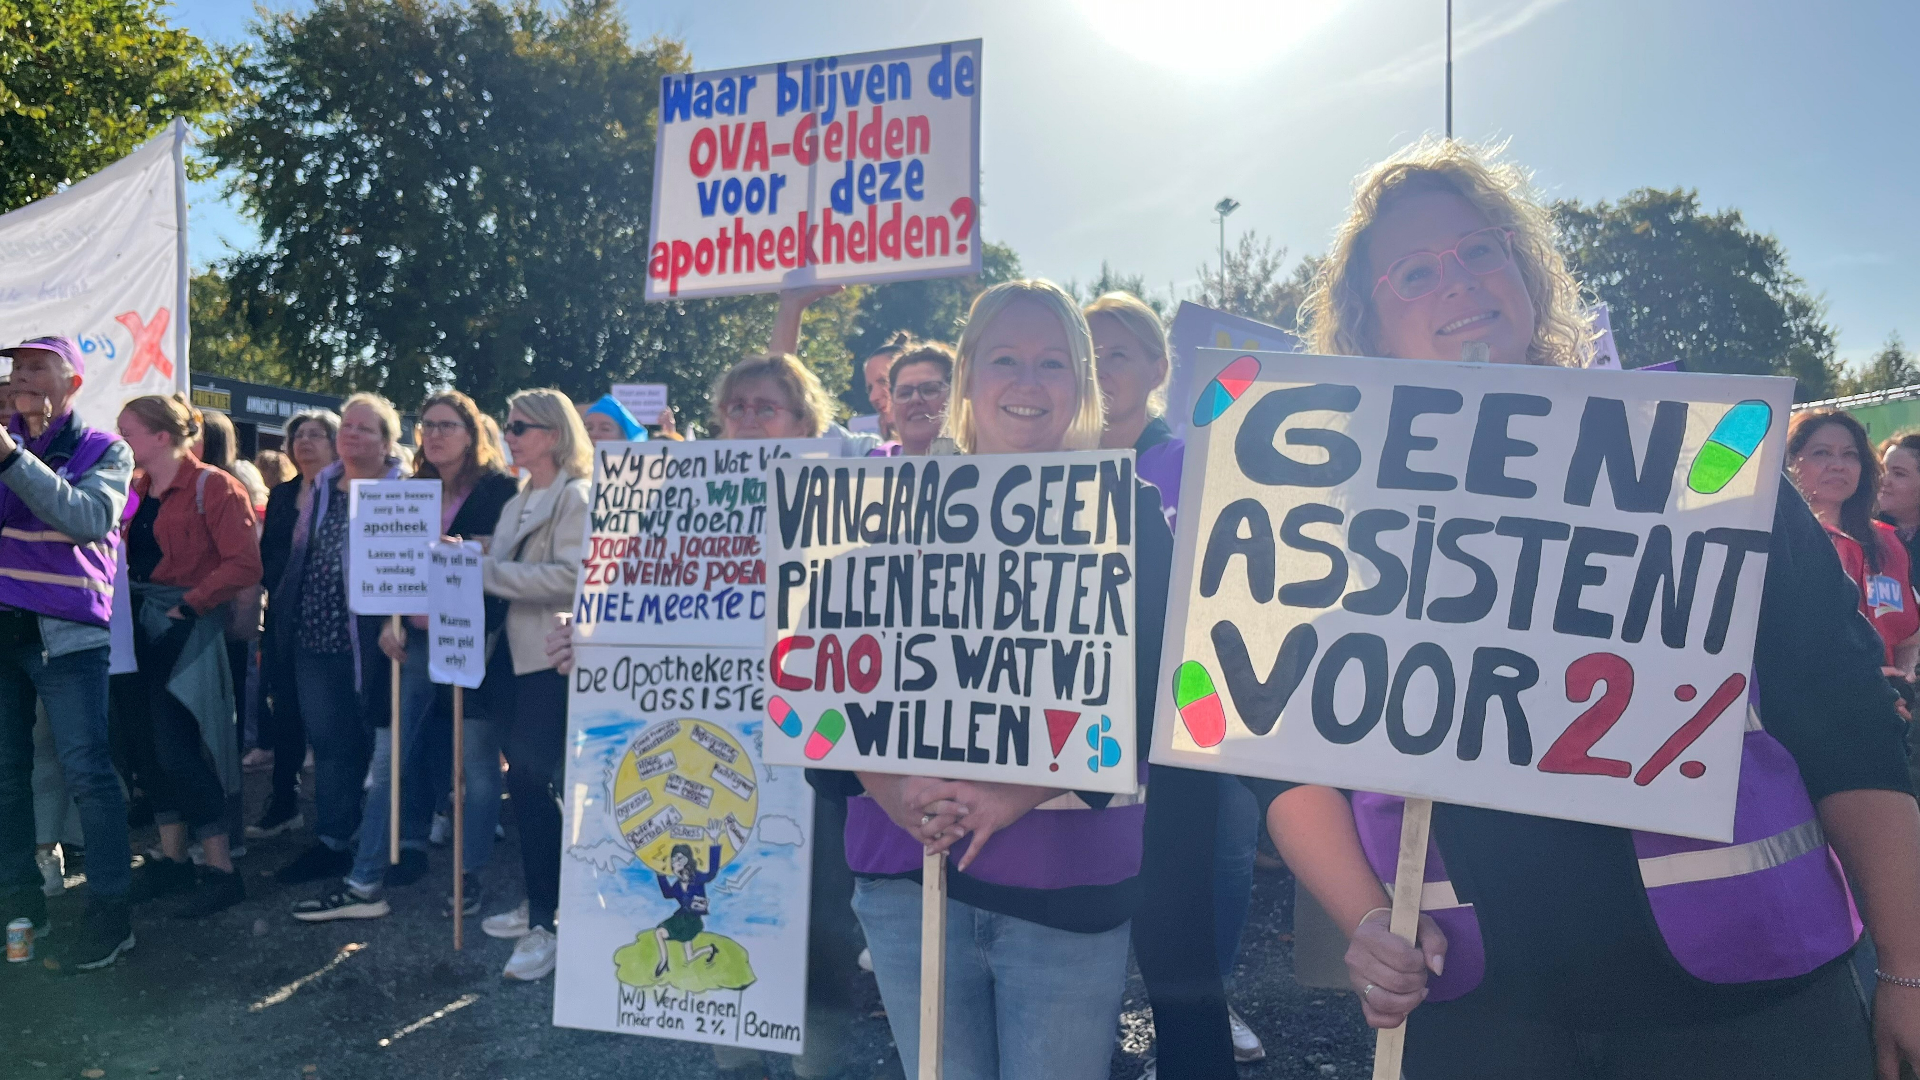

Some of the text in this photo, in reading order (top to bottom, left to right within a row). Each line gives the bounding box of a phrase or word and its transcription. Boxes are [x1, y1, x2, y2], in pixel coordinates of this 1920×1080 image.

[663, 44, 975, 126] Waar blijven de
[689, 105, 930, 178] OVA-Gelden
[697, 158, 924, 217] voor deze
[649, 196, 977, 297] apotheekhelden?
[649, 446, 706, 480] doen
[1234, 383, 1689, 514] GEEN
[676, 505, 744, 534] doen
[990, 457, 1132, 547] GEEN
[363, 520, 428, 536] apotheek
[368, 549, 396, 559] Laten
[399, 548, 414, 560] wij
[376, 564, 416, 576] vandaag
[362, 580, 428, 593] in de steek
[993, 549, 1132, 636] BETER
[576, 666, 608, 693] De
[950, 634, 1048, 698] WAT
[1210, 619, 1540, 766] VOOR
[653, 986, 738, 1018] Verdienen
[656, 1010, 685, 1031] dan
